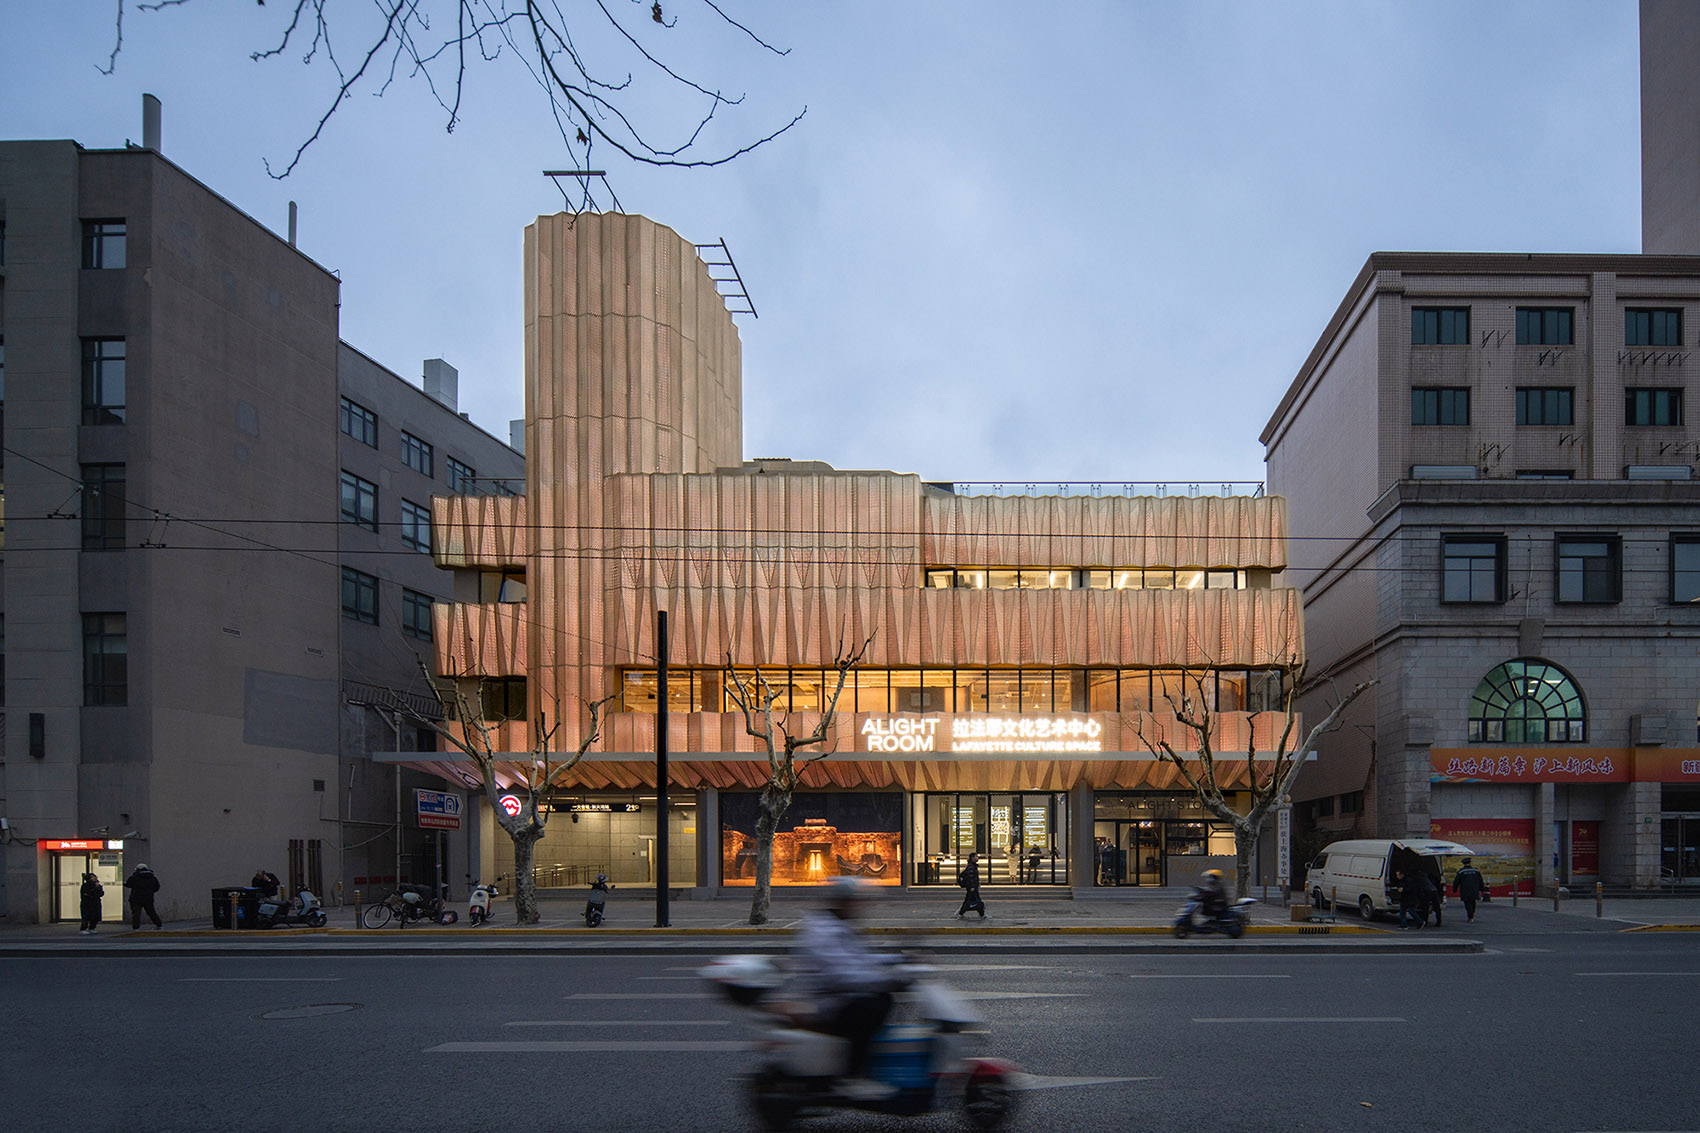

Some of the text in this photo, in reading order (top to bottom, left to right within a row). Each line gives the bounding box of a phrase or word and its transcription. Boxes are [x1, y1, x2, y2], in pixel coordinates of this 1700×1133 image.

[861, 718, 940, 735] ALIGHT
[952, 718, 1101, 738] 拉法耶文化艺术中心
[867, 735, 934, 752] ROOM
[952, 741, 1101, 752] LAFAYETTE CULTURE SPACE
[1447, 755, 1615, 776] 丝路新篇章 沪上新风味
[1127, 800, 1173, 810] ALIGHT
